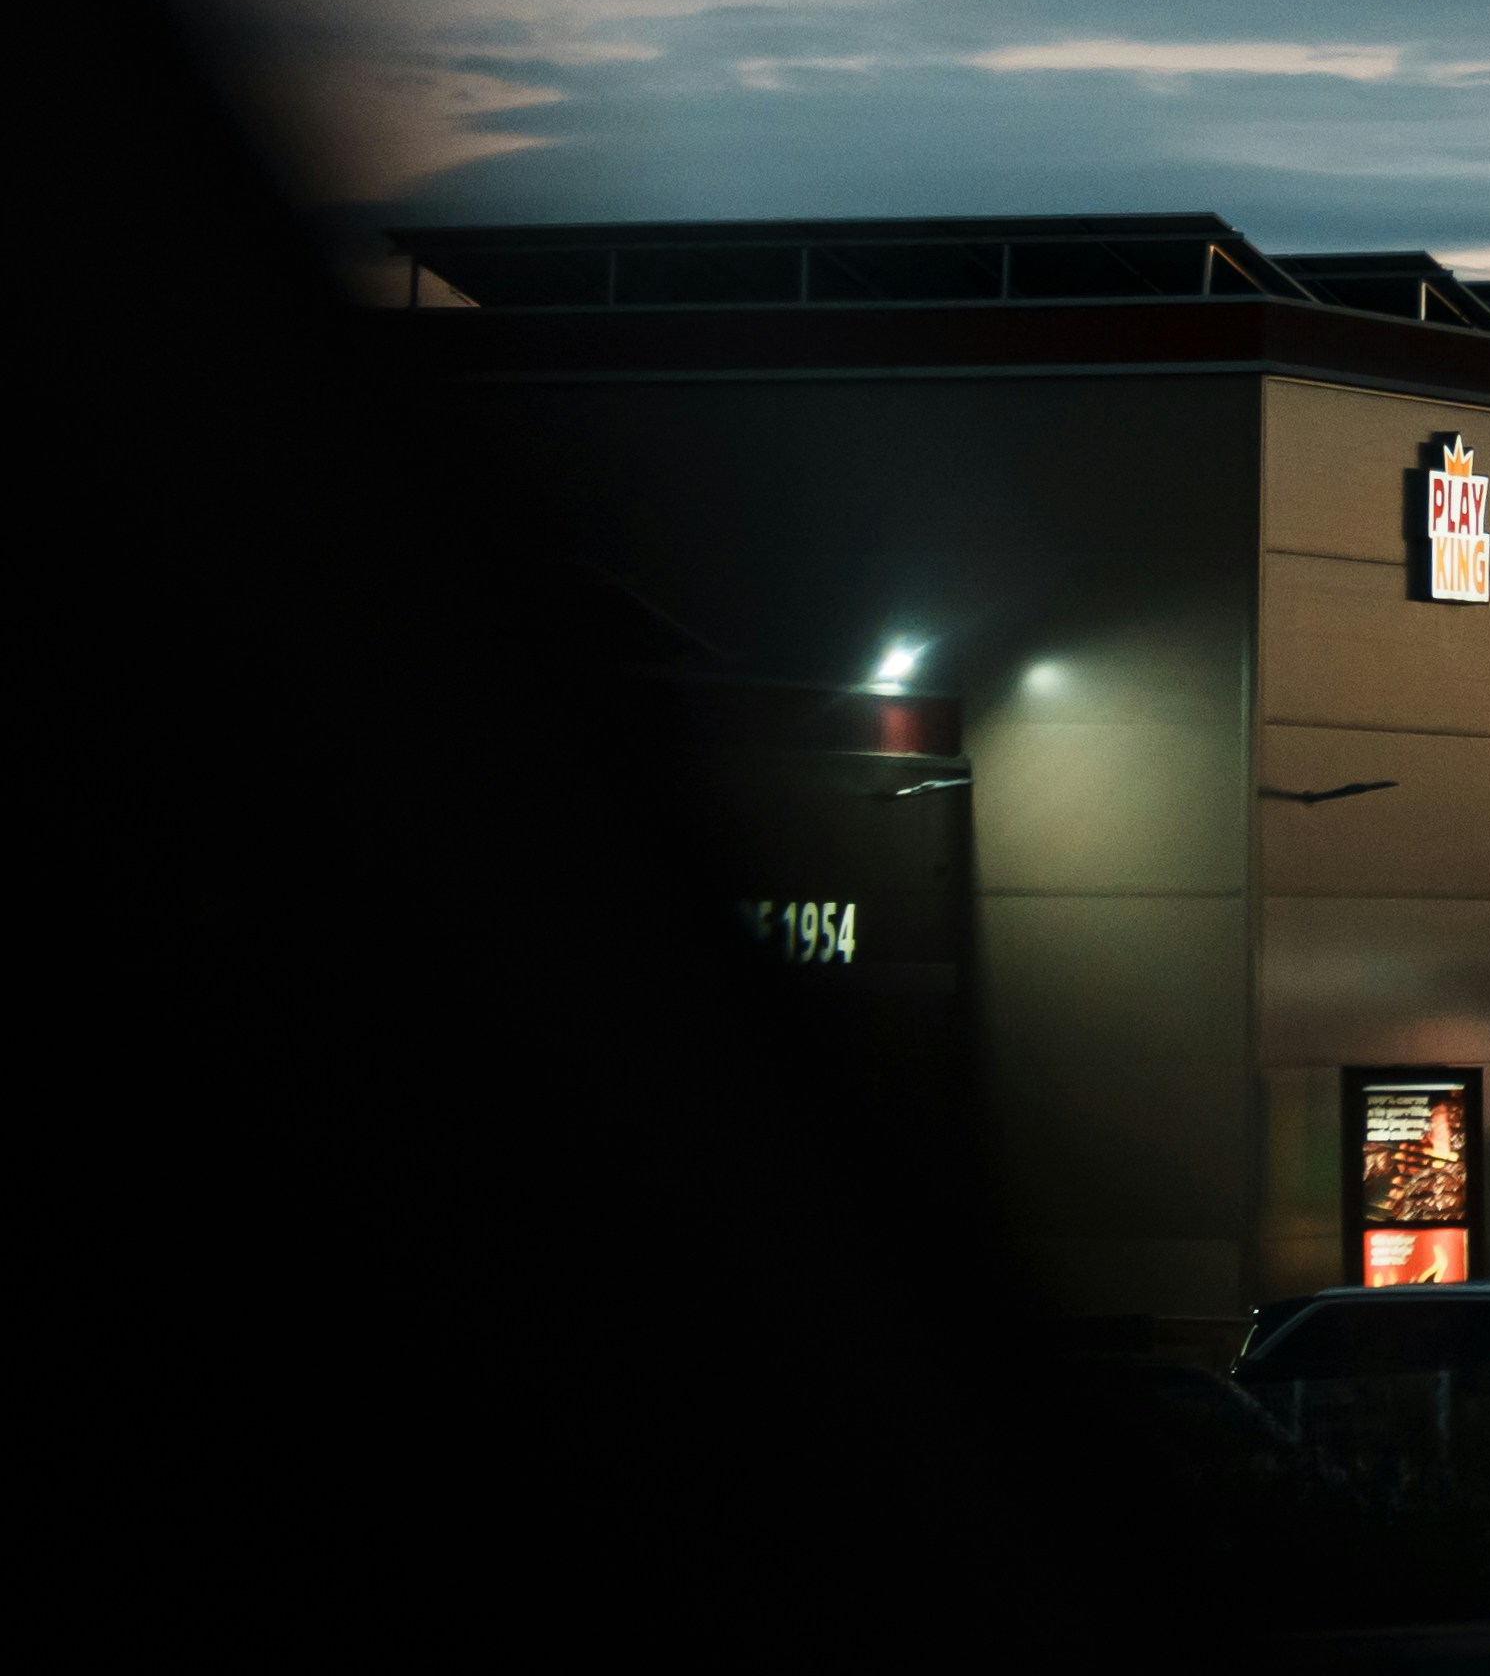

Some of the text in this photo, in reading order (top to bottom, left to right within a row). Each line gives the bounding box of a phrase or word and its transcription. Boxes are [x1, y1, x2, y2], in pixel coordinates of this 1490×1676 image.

[1433, 478, 1485, 536] PLAY
[1436, 536, 1486, 595] KING
[783, 900, 857, 963] 1954
